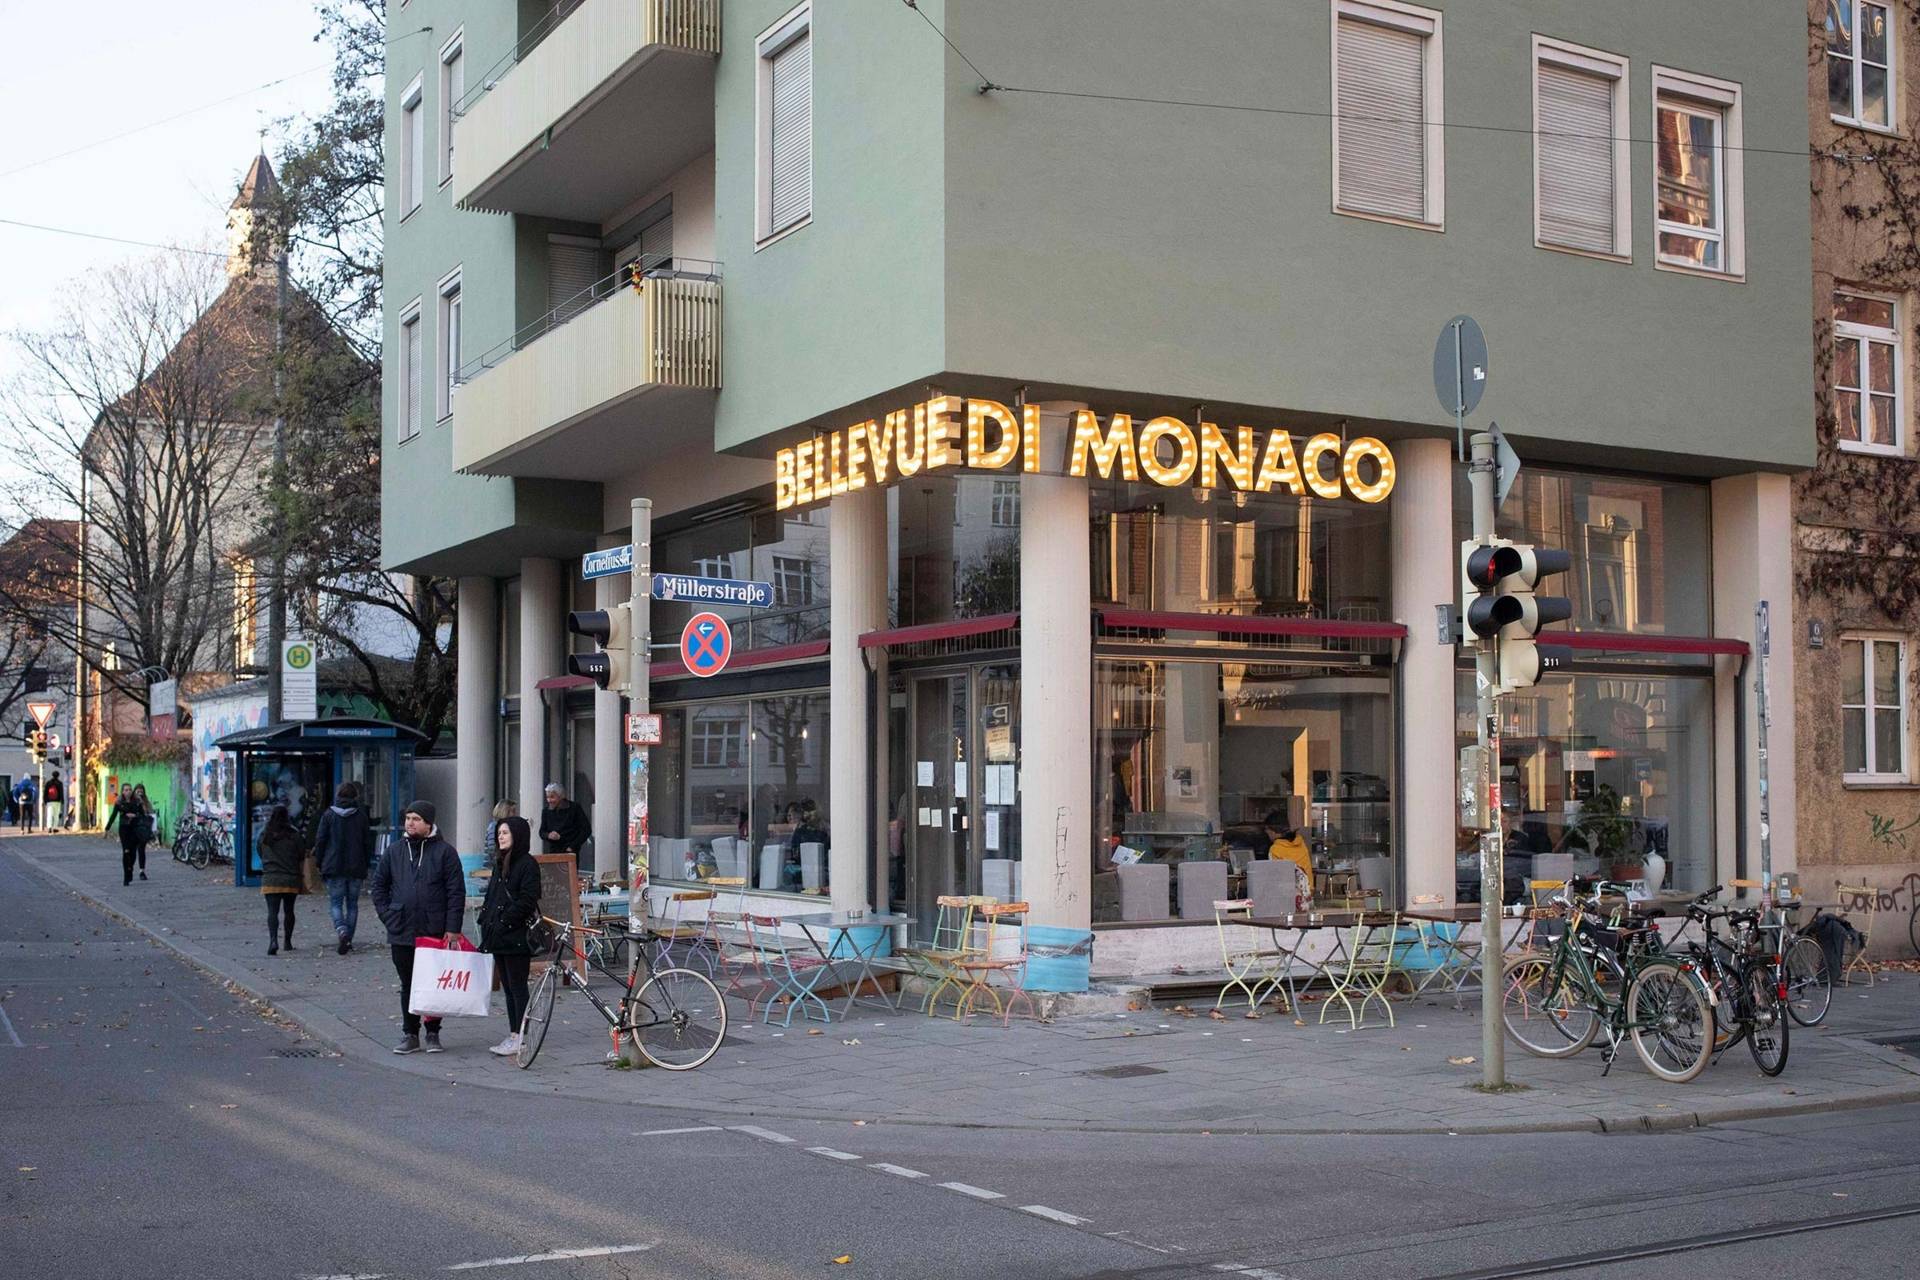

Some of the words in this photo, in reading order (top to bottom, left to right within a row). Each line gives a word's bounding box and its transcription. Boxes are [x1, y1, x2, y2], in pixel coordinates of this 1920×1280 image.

[776, 396, 954, 511] BELLEVUE
[967, 399, 1040, 473] DI
[1069, 410, 1397, 504] MONACO
[662, 577, 765, 604] Müllerstraße
[1544, 657, 1559, 666] 311
[436, 969, 471, 992] H&M
